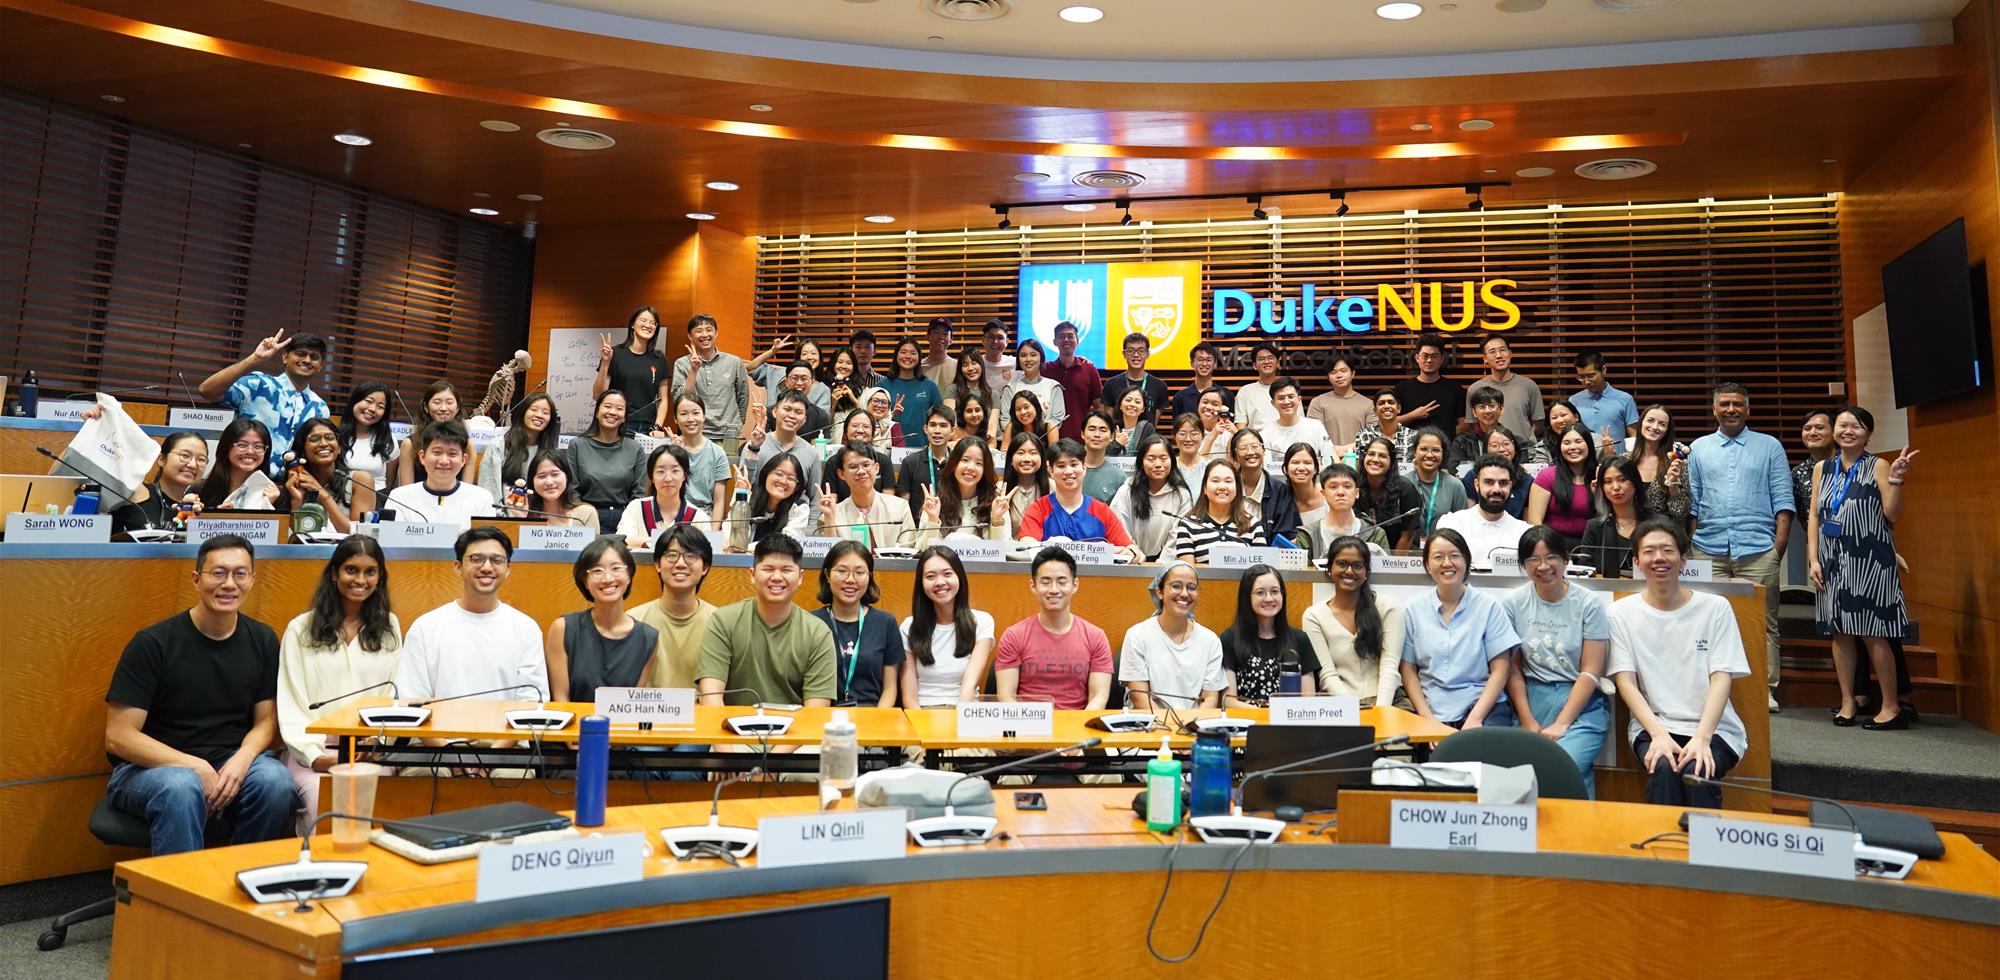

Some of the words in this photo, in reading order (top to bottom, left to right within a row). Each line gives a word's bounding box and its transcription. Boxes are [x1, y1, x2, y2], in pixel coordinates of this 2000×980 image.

[1213, 278, 1521, 335] DukeNUS
[25, 518, 56, 528] Sarah
[59, 518, 94, 528] WONG
[197, 521, 254, 531] Priyadharshini
[255, 521, 270, 529] D/O
[405, 525, 424, 534] Alan
[426, 526, 435, 534] LI
[531, 529, 543, 538] NG
[545, 529, 562, 538] Wan
[564, 530, 584, 538] Zhen
[544, 541, 569, 549] Janice
[803, 541, 832, 550] Kaiheng
[1087, 545, 1105, 553] Ryan
[981, 549, 1000, 557] Xuan
[1081, 555, 1099, 563] Feng
[1223, 555, 1237, 563] Min
[1238, 555, 1247, 563] Ju
[1381, 559, 1408, 568] Wesley
[628, 689, 663, 699] Valerie
[609, 704, 632, 713] ANG
[635, 704, 655, 713] Han
[657, 704, 681, 716] Ning
[963, 708, 1000, 718] CHENG
[1002, 708, 1019, 718] Hui
[1021, 708, 1046, 719] Kang
[1287, 708, 1317, 718] Brahm
[1319, 708, 1343, 718] Preet
[1399, 808, 1447, 824] CHOW
[1450, 810, 1478, 825] Jun
[1481, 811, 1528, 831] Zhong
[801, 823, 826, 841] LIN
[831, 820, 865, 839] Qinli
[1449, 831, 1478, 846] Earl
[1715, 827, 1779, 848] YOONG
[1784, 833, 1801, 850] Si
[1805, 836, 1824, 853] Qi
[511, 850, 562, 872] DENG
[566, 847, 615, 868] Qiyun
